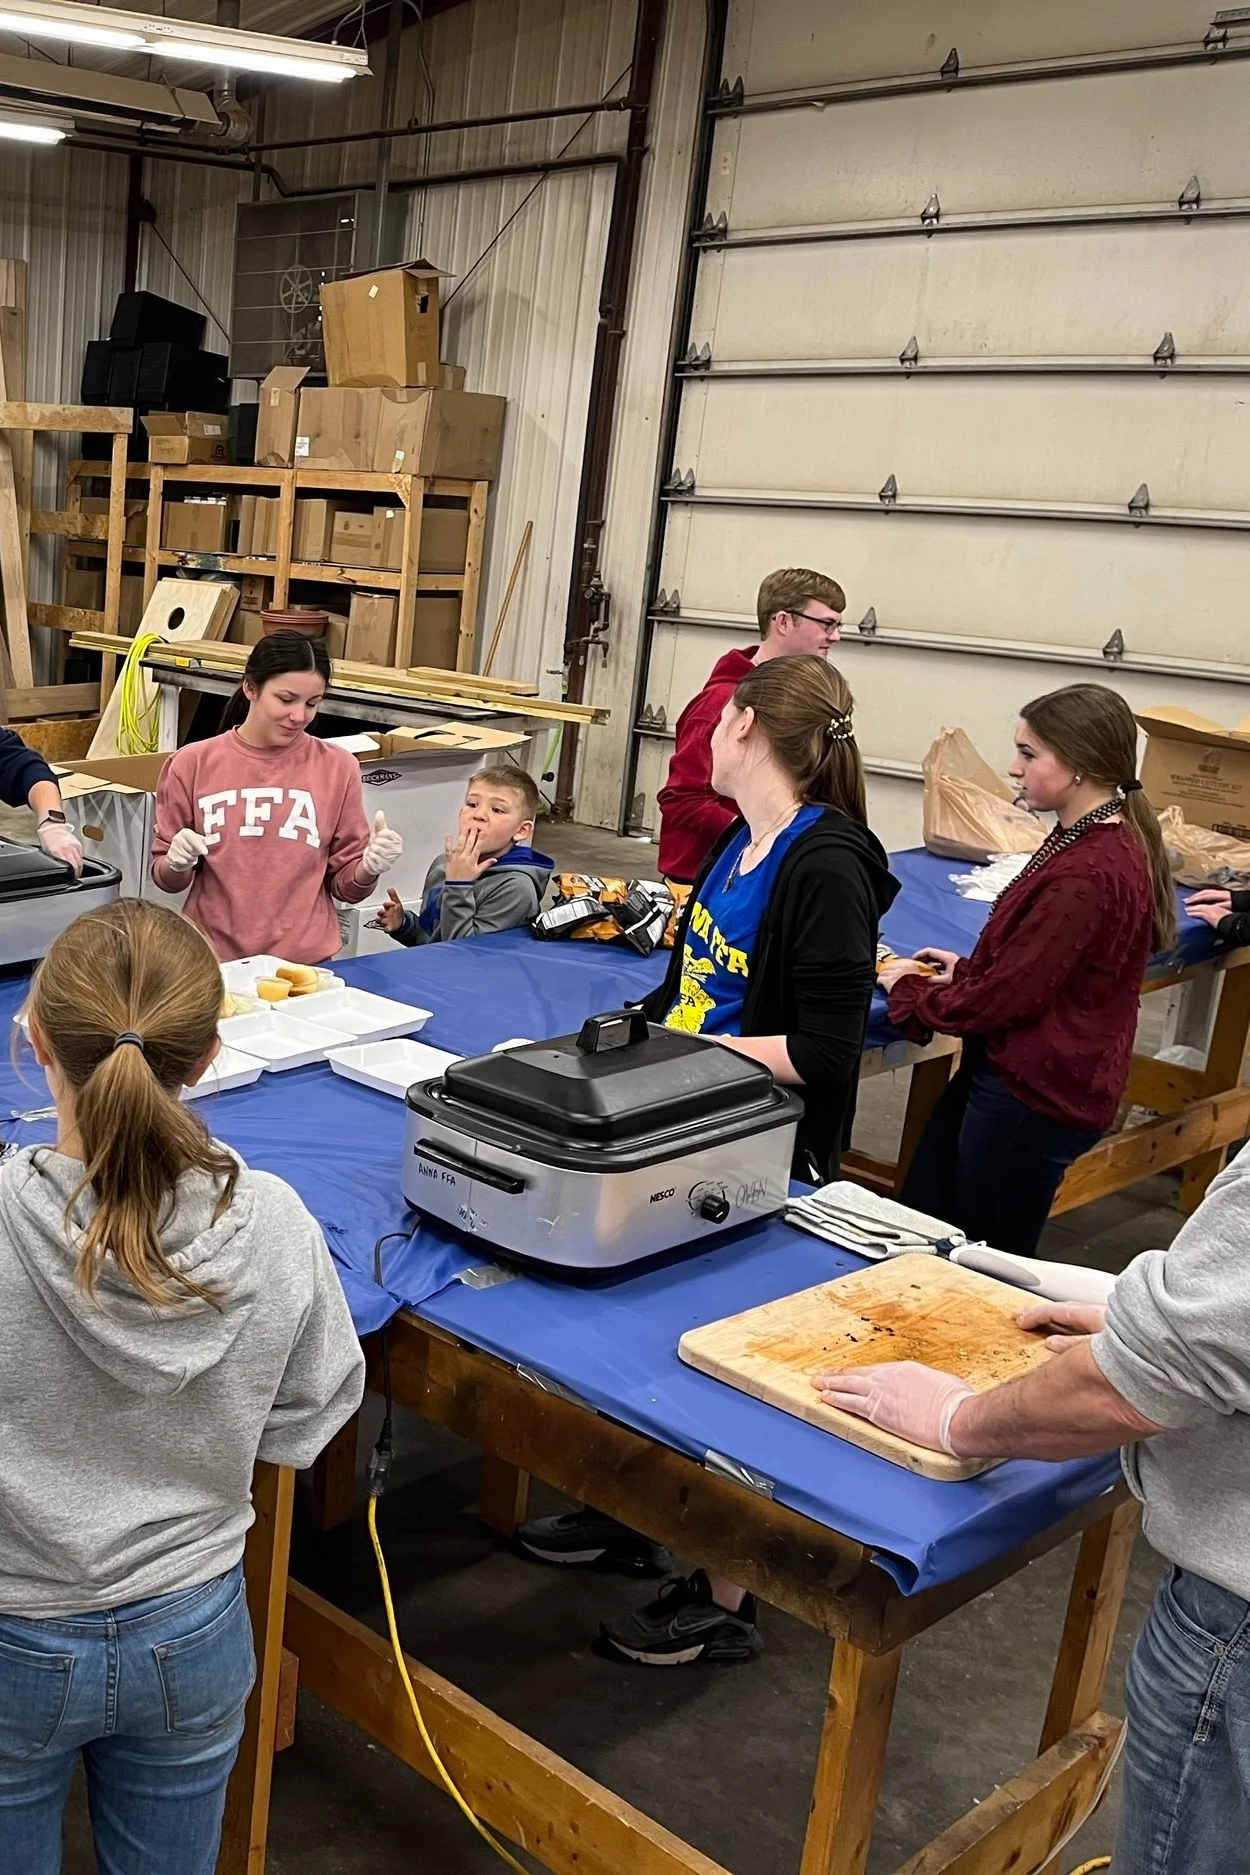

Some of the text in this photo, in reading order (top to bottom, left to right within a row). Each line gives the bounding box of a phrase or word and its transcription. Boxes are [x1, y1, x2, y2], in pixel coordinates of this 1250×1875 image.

[198, 787, 321, 849] FFA
[418, 1162, 456, 1186] ANNA FFA
[650, 1187, 676, 1203] NESCO
[735, 1177, 768, 1208] OVEN
